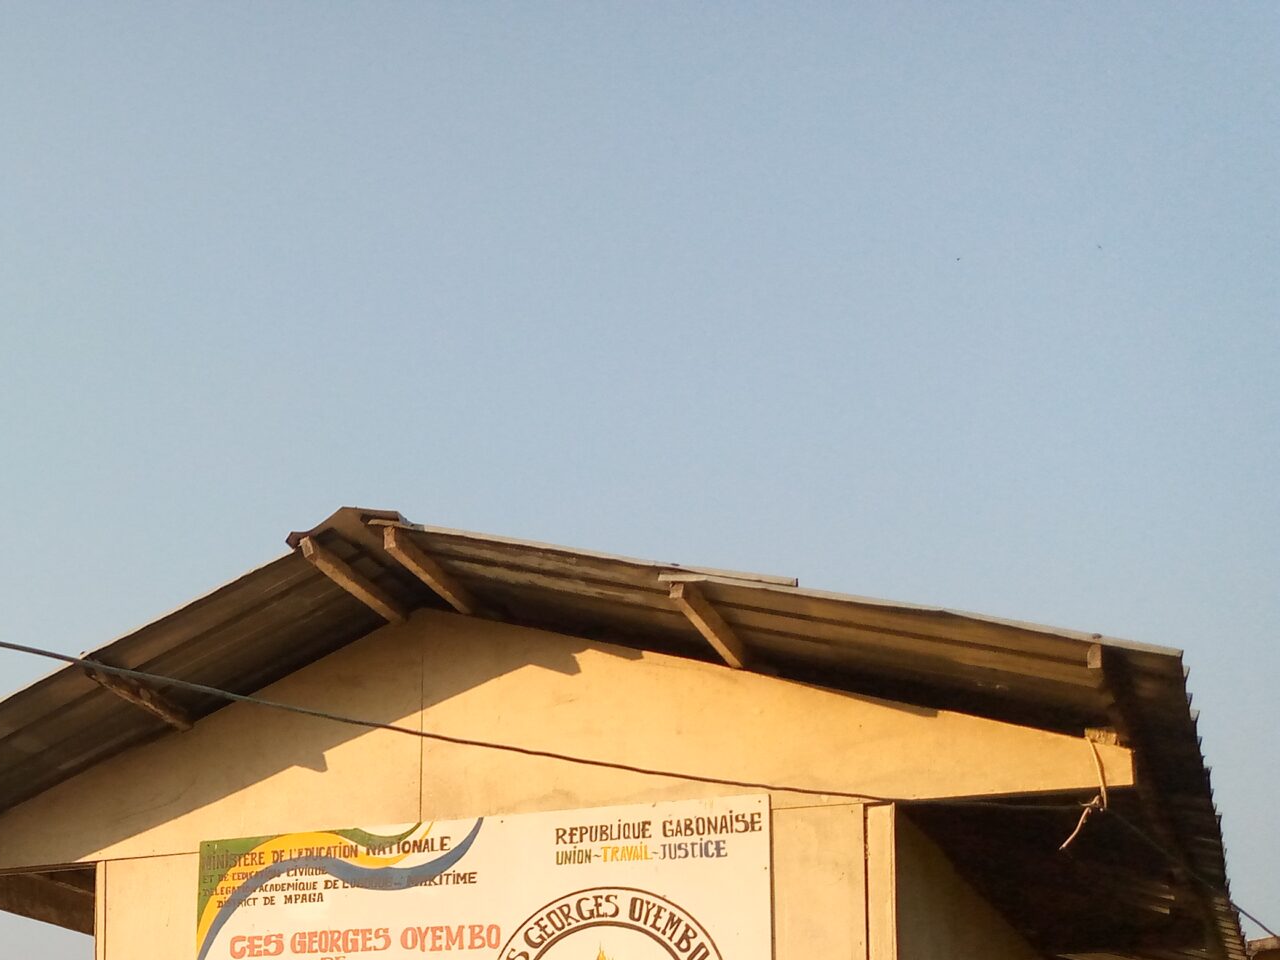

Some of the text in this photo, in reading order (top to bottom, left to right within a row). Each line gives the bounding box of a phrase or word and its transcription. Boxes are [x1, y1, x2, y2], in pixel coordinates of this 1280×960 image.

[555, 810, 763, 845] REPUBLIQUE GABONAISE
[271, 849, 285, 862] DE
[365, 836, 452, 856] NATIONALE
[259, 879, 318, 893] ACADEMIQUE
[324, 879, 339, 890] DE
[263, 896, 276, 906] DE
[284, 892, 324, 904] MPAGA
[523, 894, 620, 949] GEORGES
[229, 924, 502, 960] CES GEORGES OYEMBO
